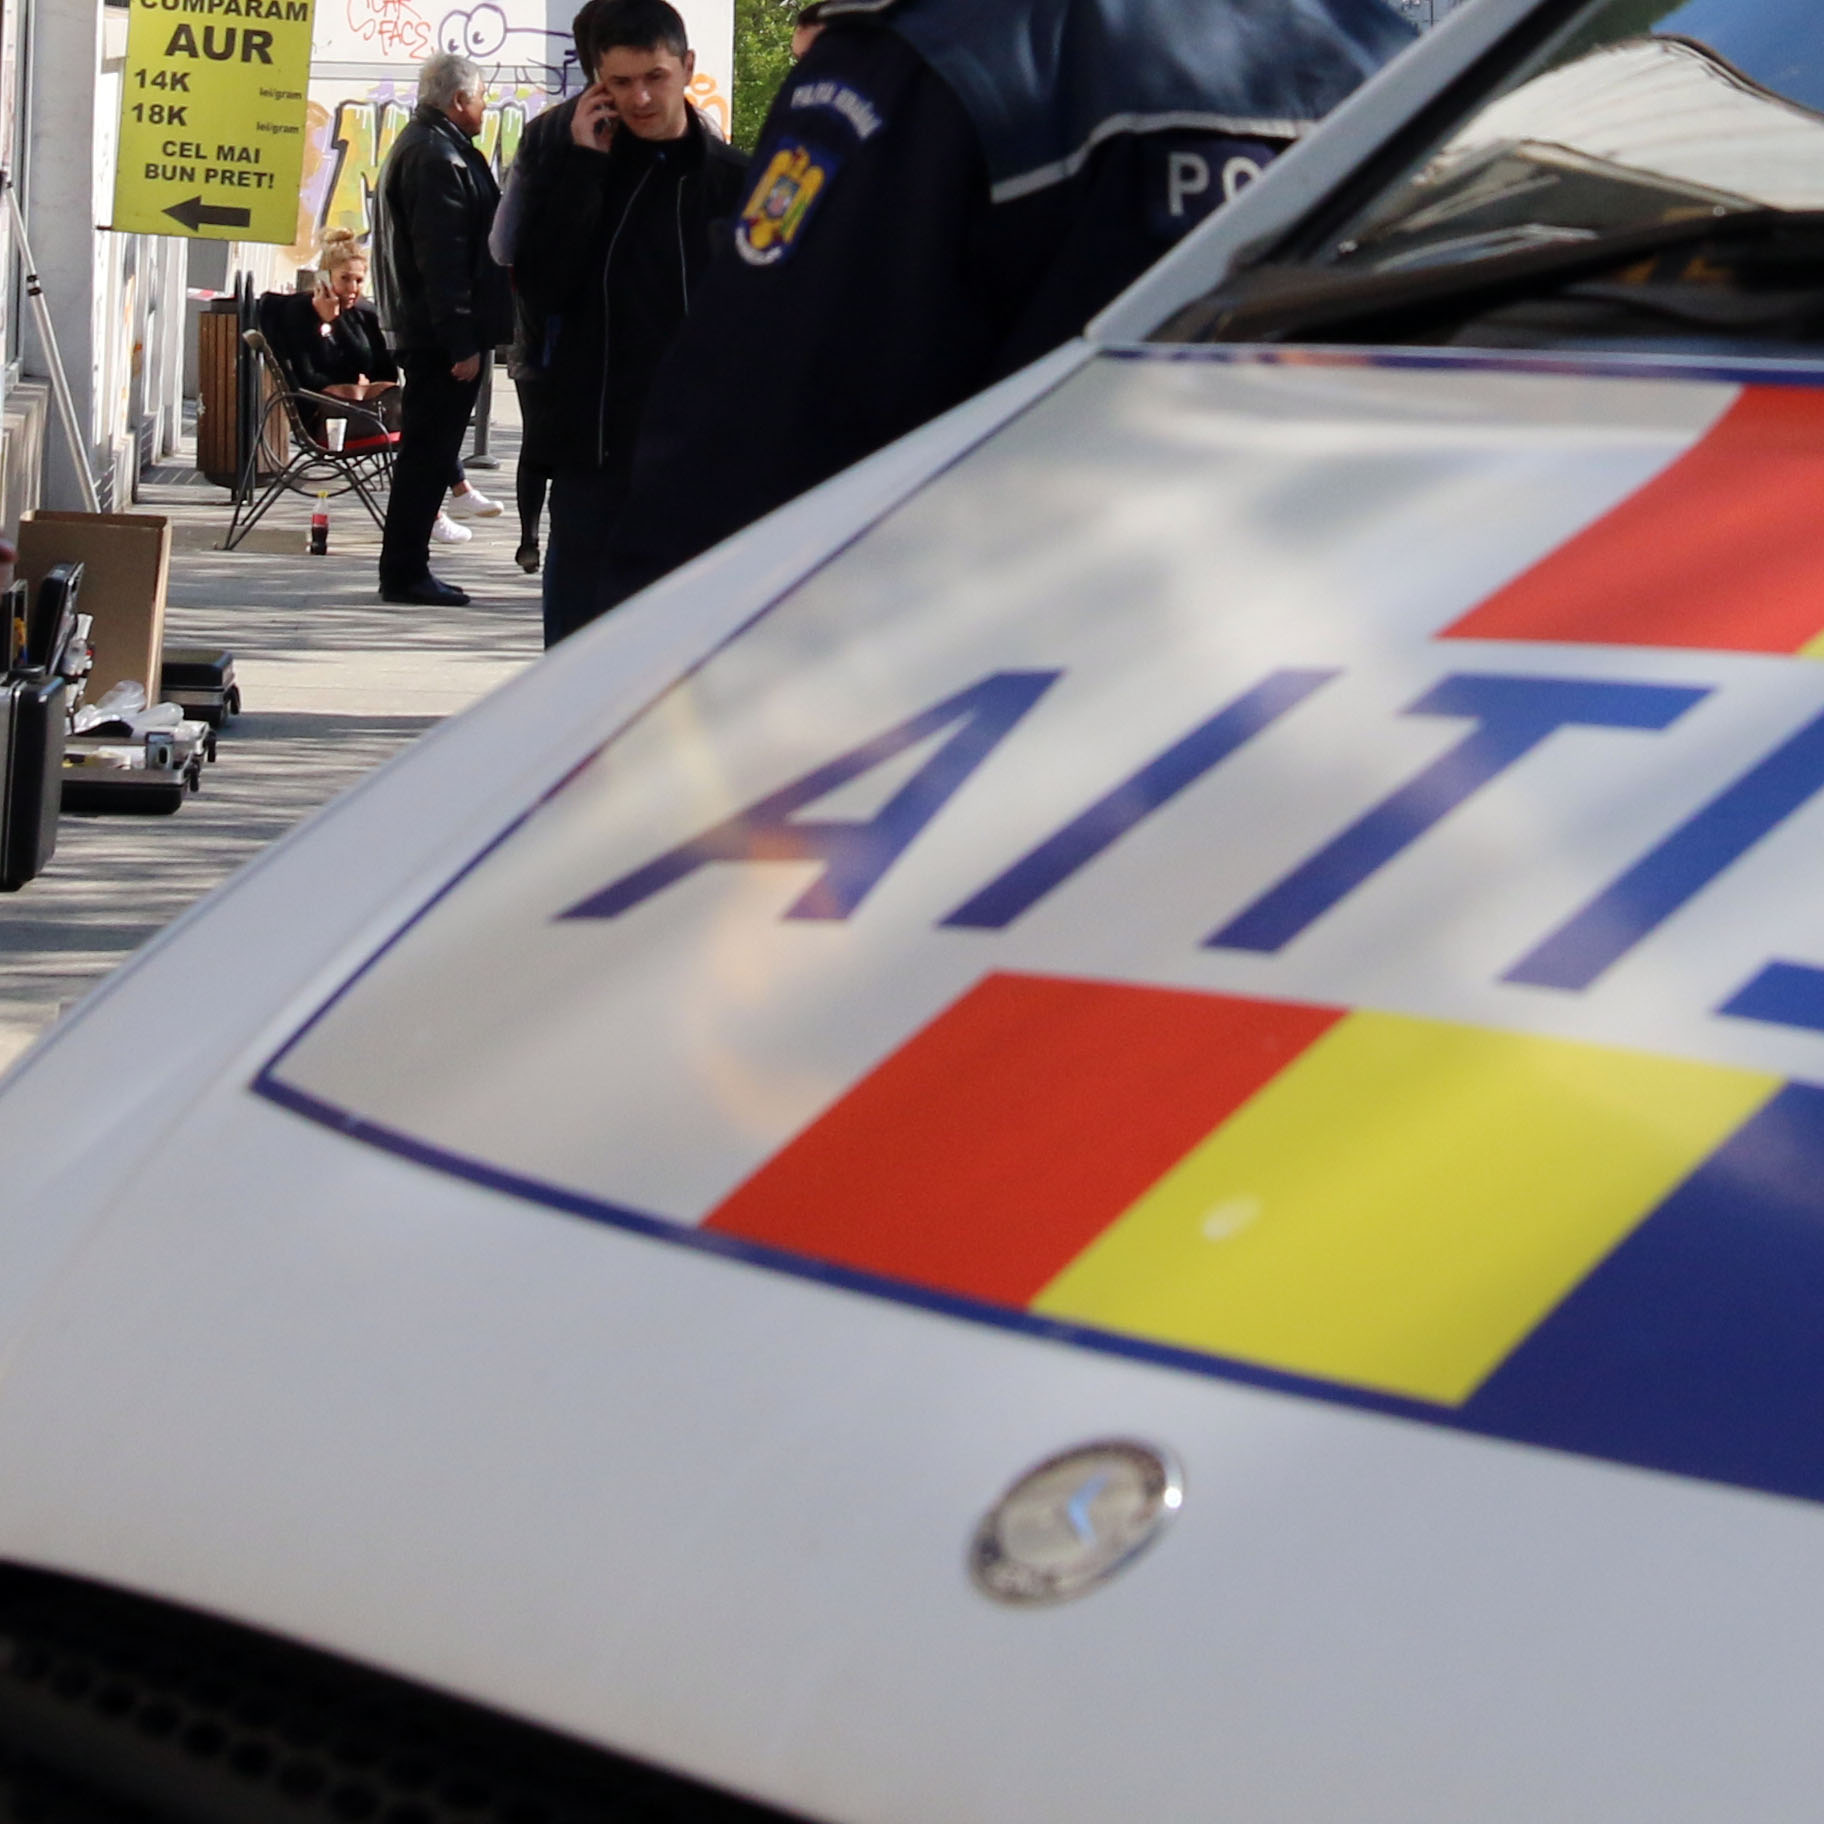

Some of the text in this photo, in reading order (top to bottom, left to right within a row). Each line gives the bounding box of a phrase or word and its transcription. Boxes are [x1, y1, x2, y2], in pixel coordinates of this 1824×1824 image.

[164, 23, 274, 65] AUR
[134, 68, 191, 93] 14K
[131, 103, 189, 127] 18K
[162, 140, 261, 164] CEL MAI
[144, 163, 274, 189] BUN PRET!
